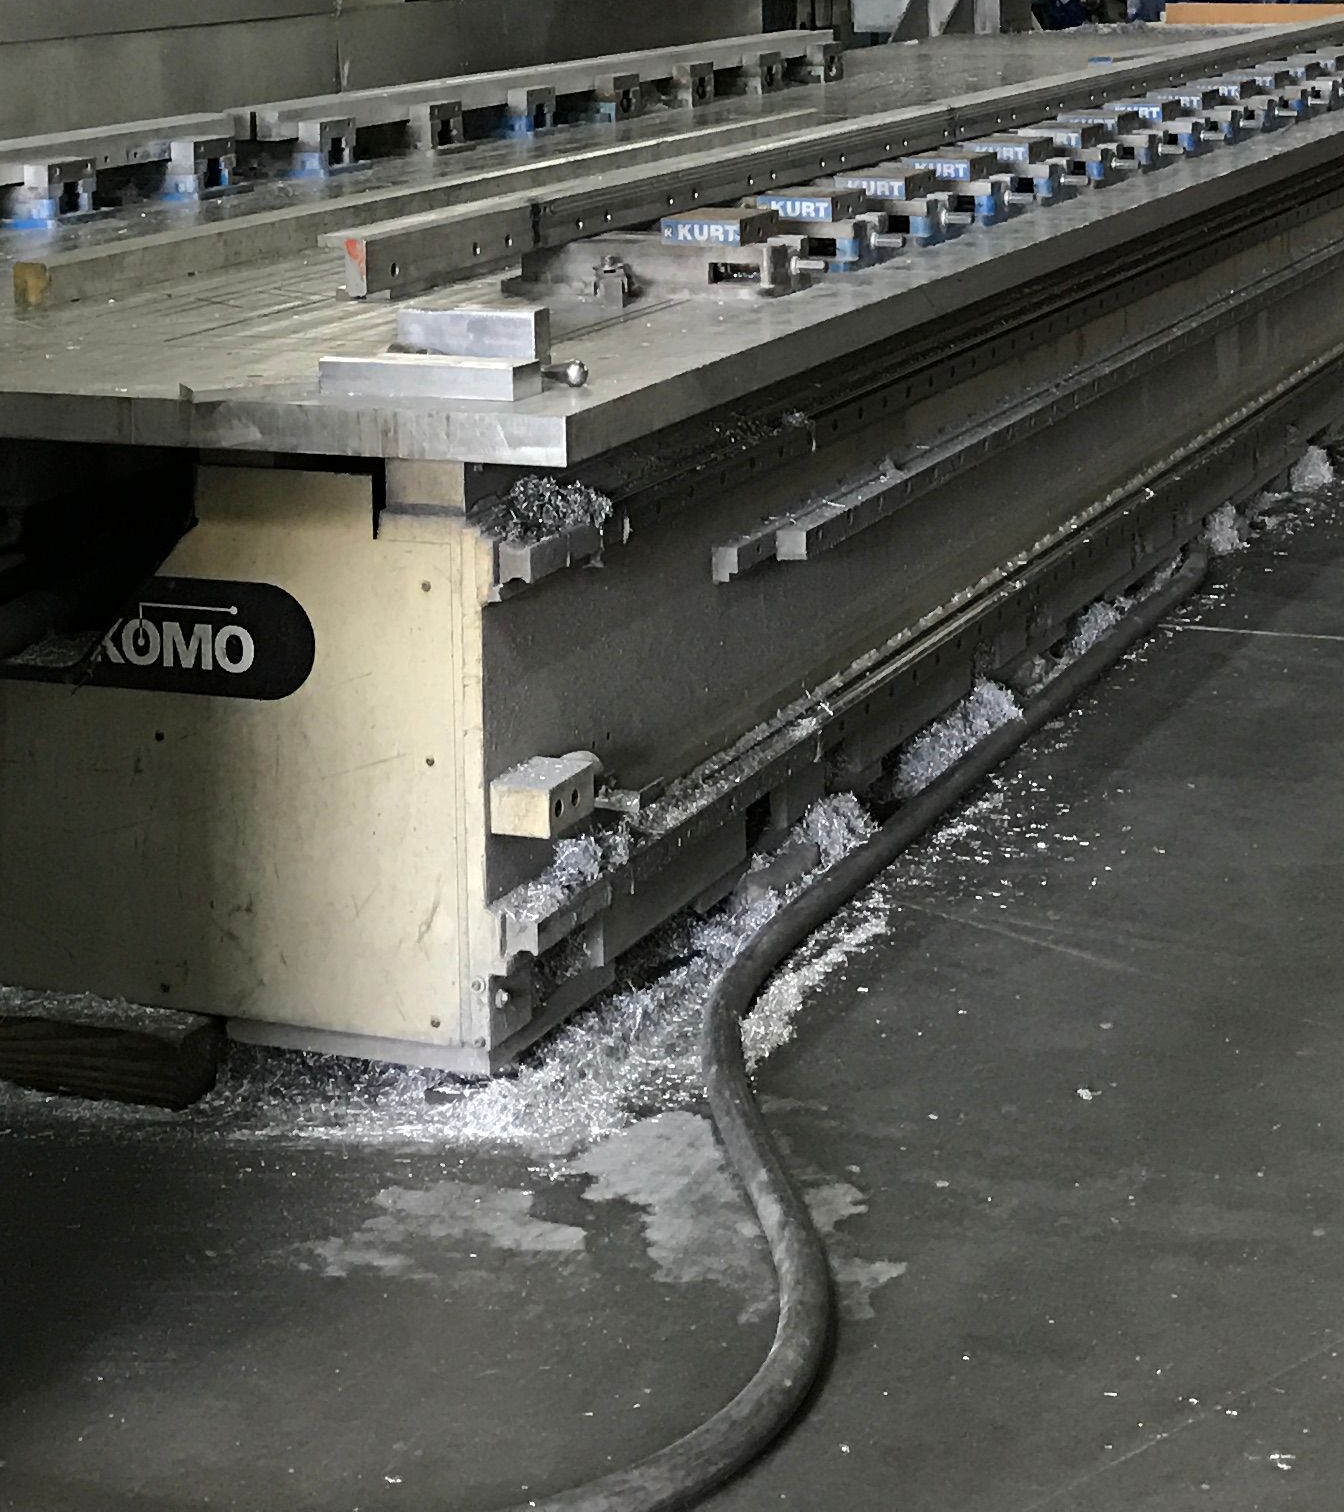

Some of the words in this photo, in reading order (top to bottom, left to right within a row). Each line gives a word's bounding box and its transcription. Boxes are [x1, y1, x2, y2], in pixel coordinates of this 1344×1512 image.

[770, 200, 829, 218] KURT
[677, 223, 737, 242] KURT
[92, 618, 255, 674] KOMO
